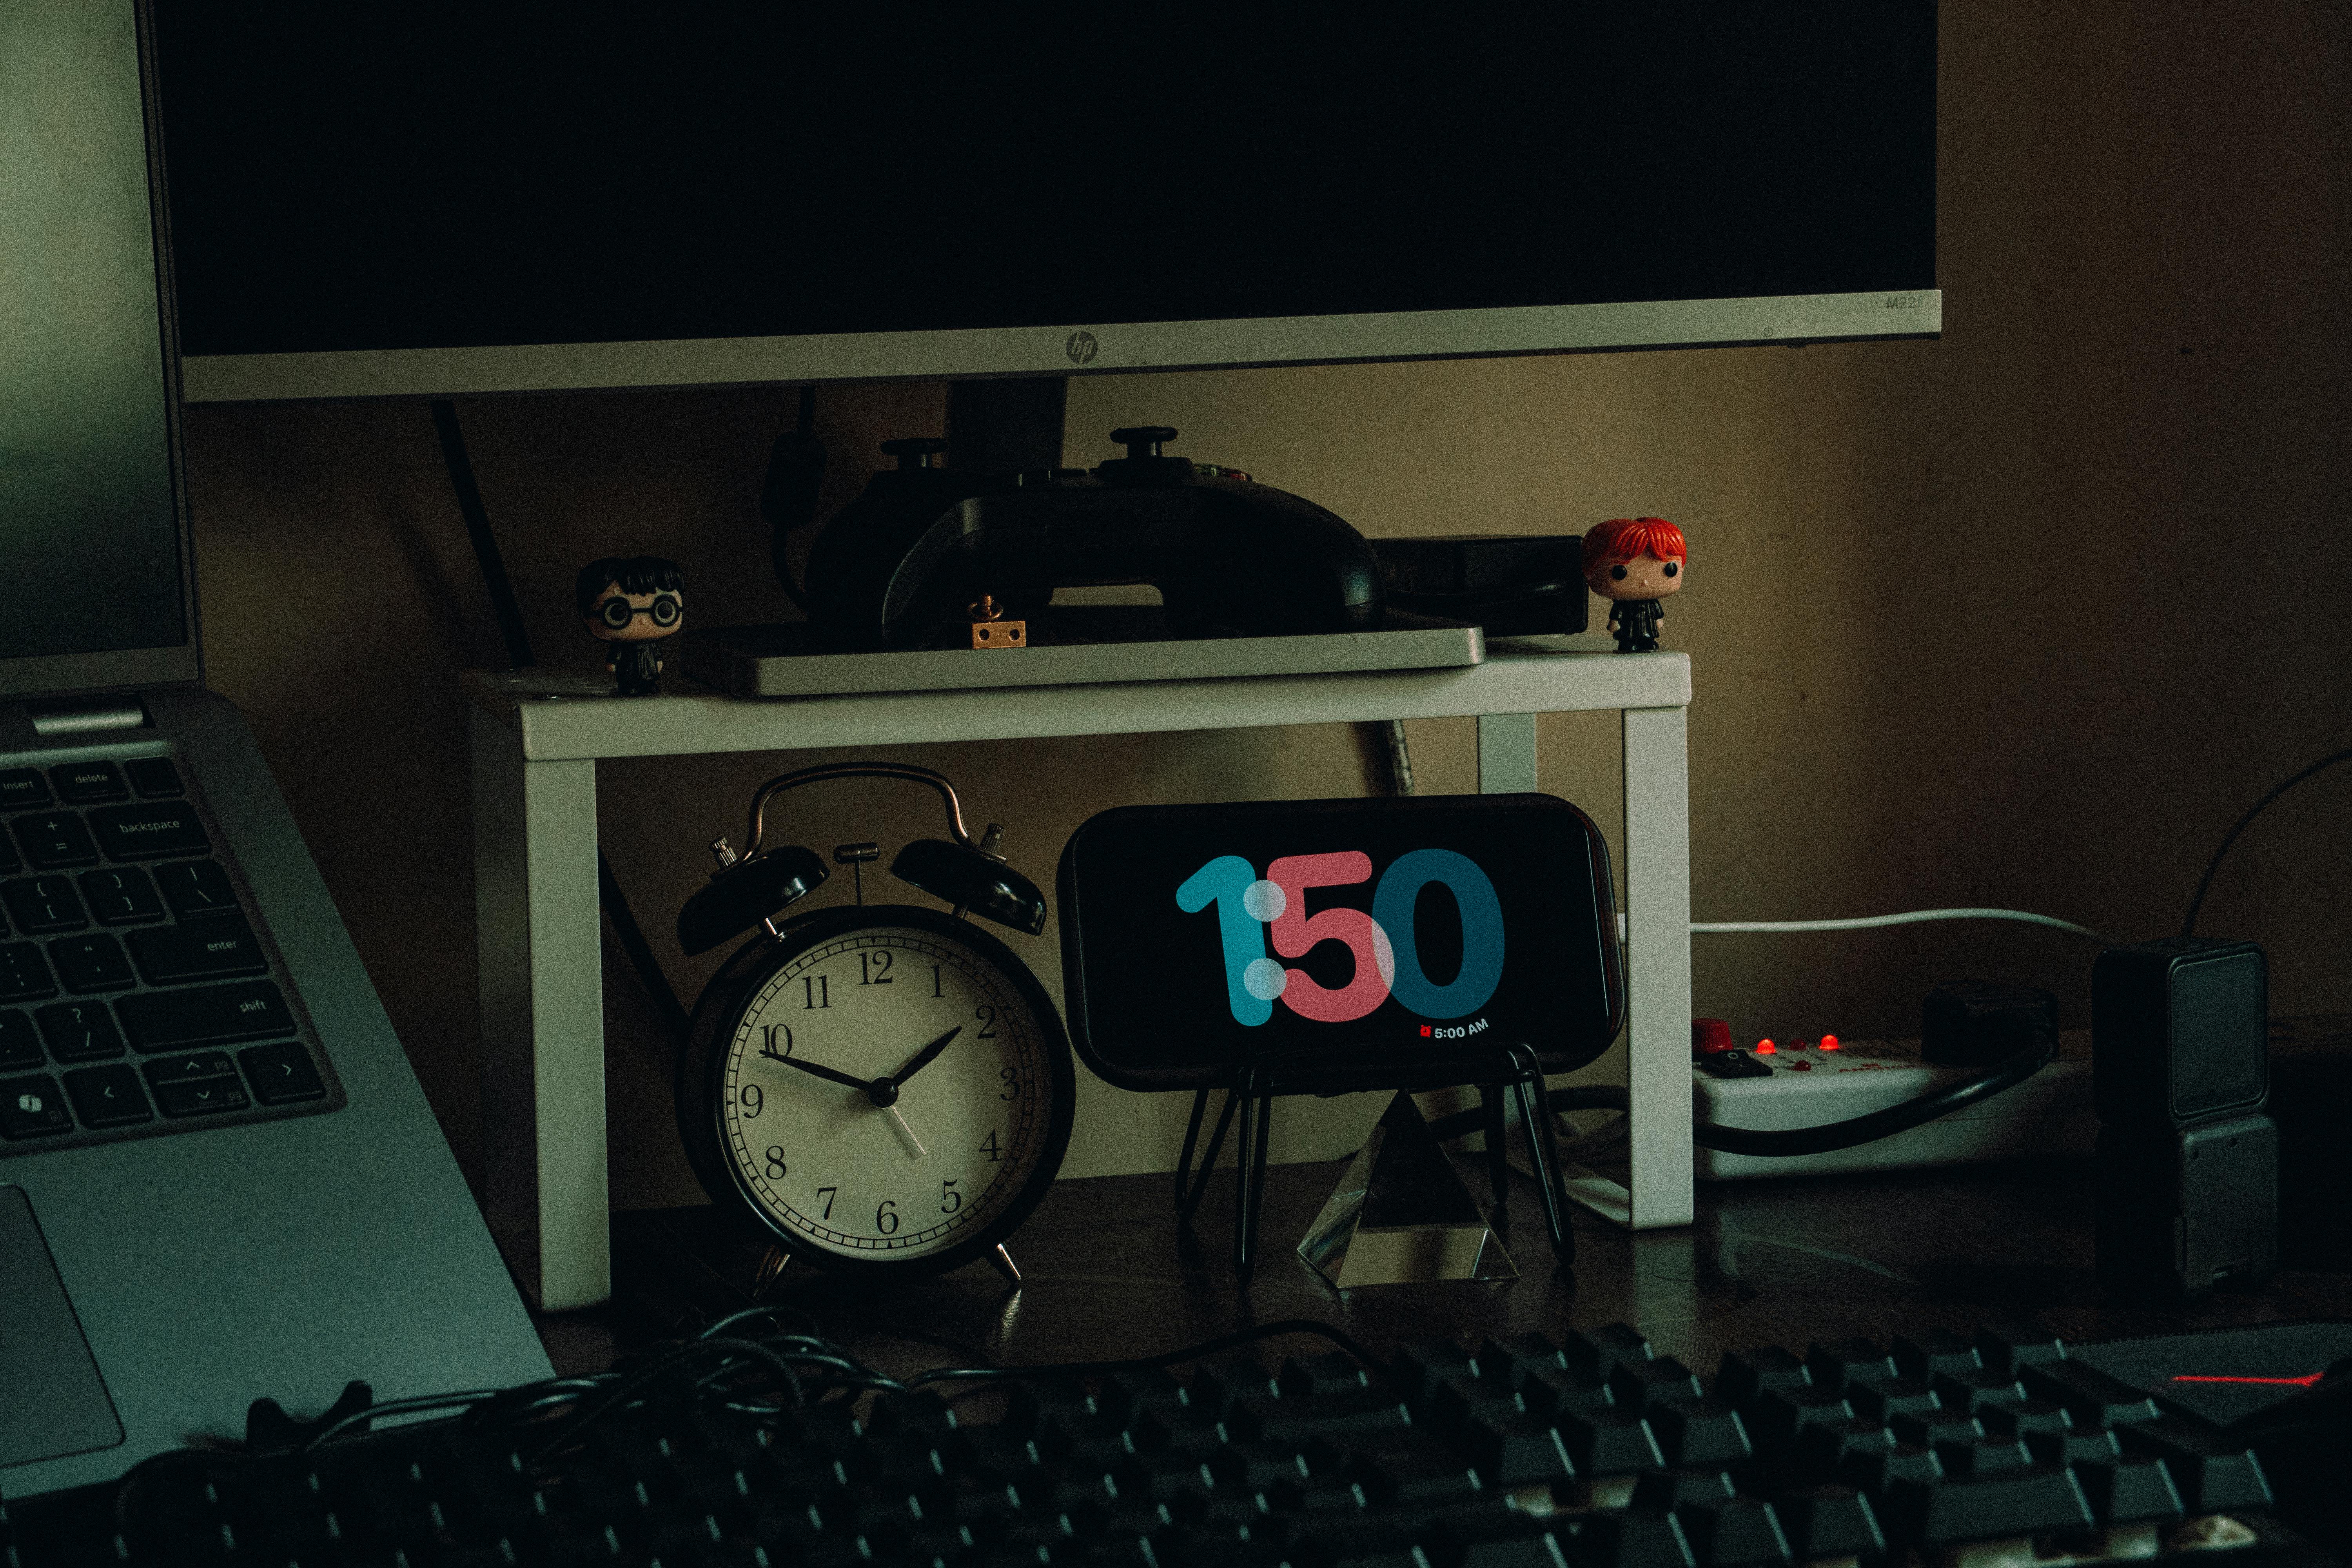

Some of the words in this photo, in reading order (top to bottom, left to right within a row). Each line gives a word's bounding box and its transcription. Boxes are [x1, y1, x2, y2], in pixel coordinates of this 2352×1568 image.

[1887, 296, 1922, 309] M22f
[1070, 332, 1095, 364] hp
[2, 779, 35, 790] insert
[74, 773, 108, 784] delete
[119, 819, 180, 834] backspace
[207, 939, 237, 952] enter
[858, 950, 893, 985] 12
[930, 964, 945, 998] 1
[239, 999, 267, 1013] shift
[802, 975, 832, 1009] 11
[976, 1005, 996, 1038] 2
[1435, 1027, 1465, 1038] 5:00
[1469, 1018, 1489, 1035] AM
[760, 1024, 793, 1058] 10
[1000, 1067, 1020, 1101] 3
[741, 1084, 763, 1118] 9
[979, 1129, 1002, 1162] 4
[765, 1146, 786, 1180] 8
[817, 1187, 837, 1220] 7
[941, 1179, 961, 1213] 5
[876, 1200, 898, 1234] 6
